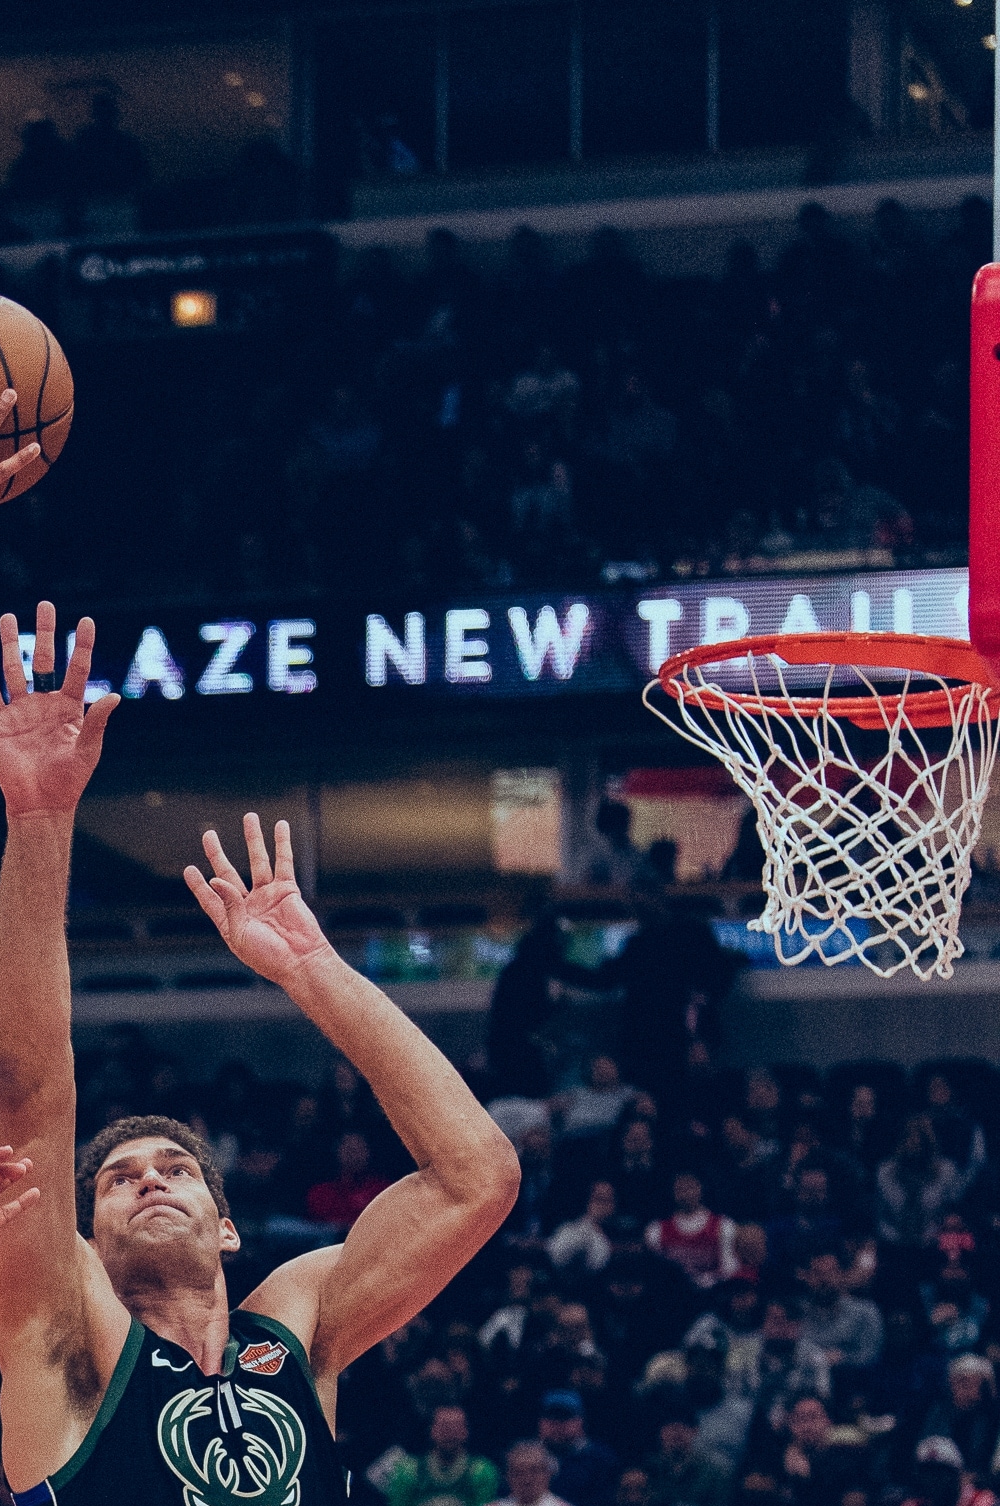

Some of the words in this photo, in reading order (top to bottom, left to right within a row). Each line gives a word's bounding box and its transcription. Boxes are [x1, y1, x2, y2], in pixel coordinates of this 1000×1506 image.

[365, 603, 590, 687] NEW
[636, 586, 970, 676] TRAI
[241, 1348, 283, 1369] RLEY-DAVIDSON
